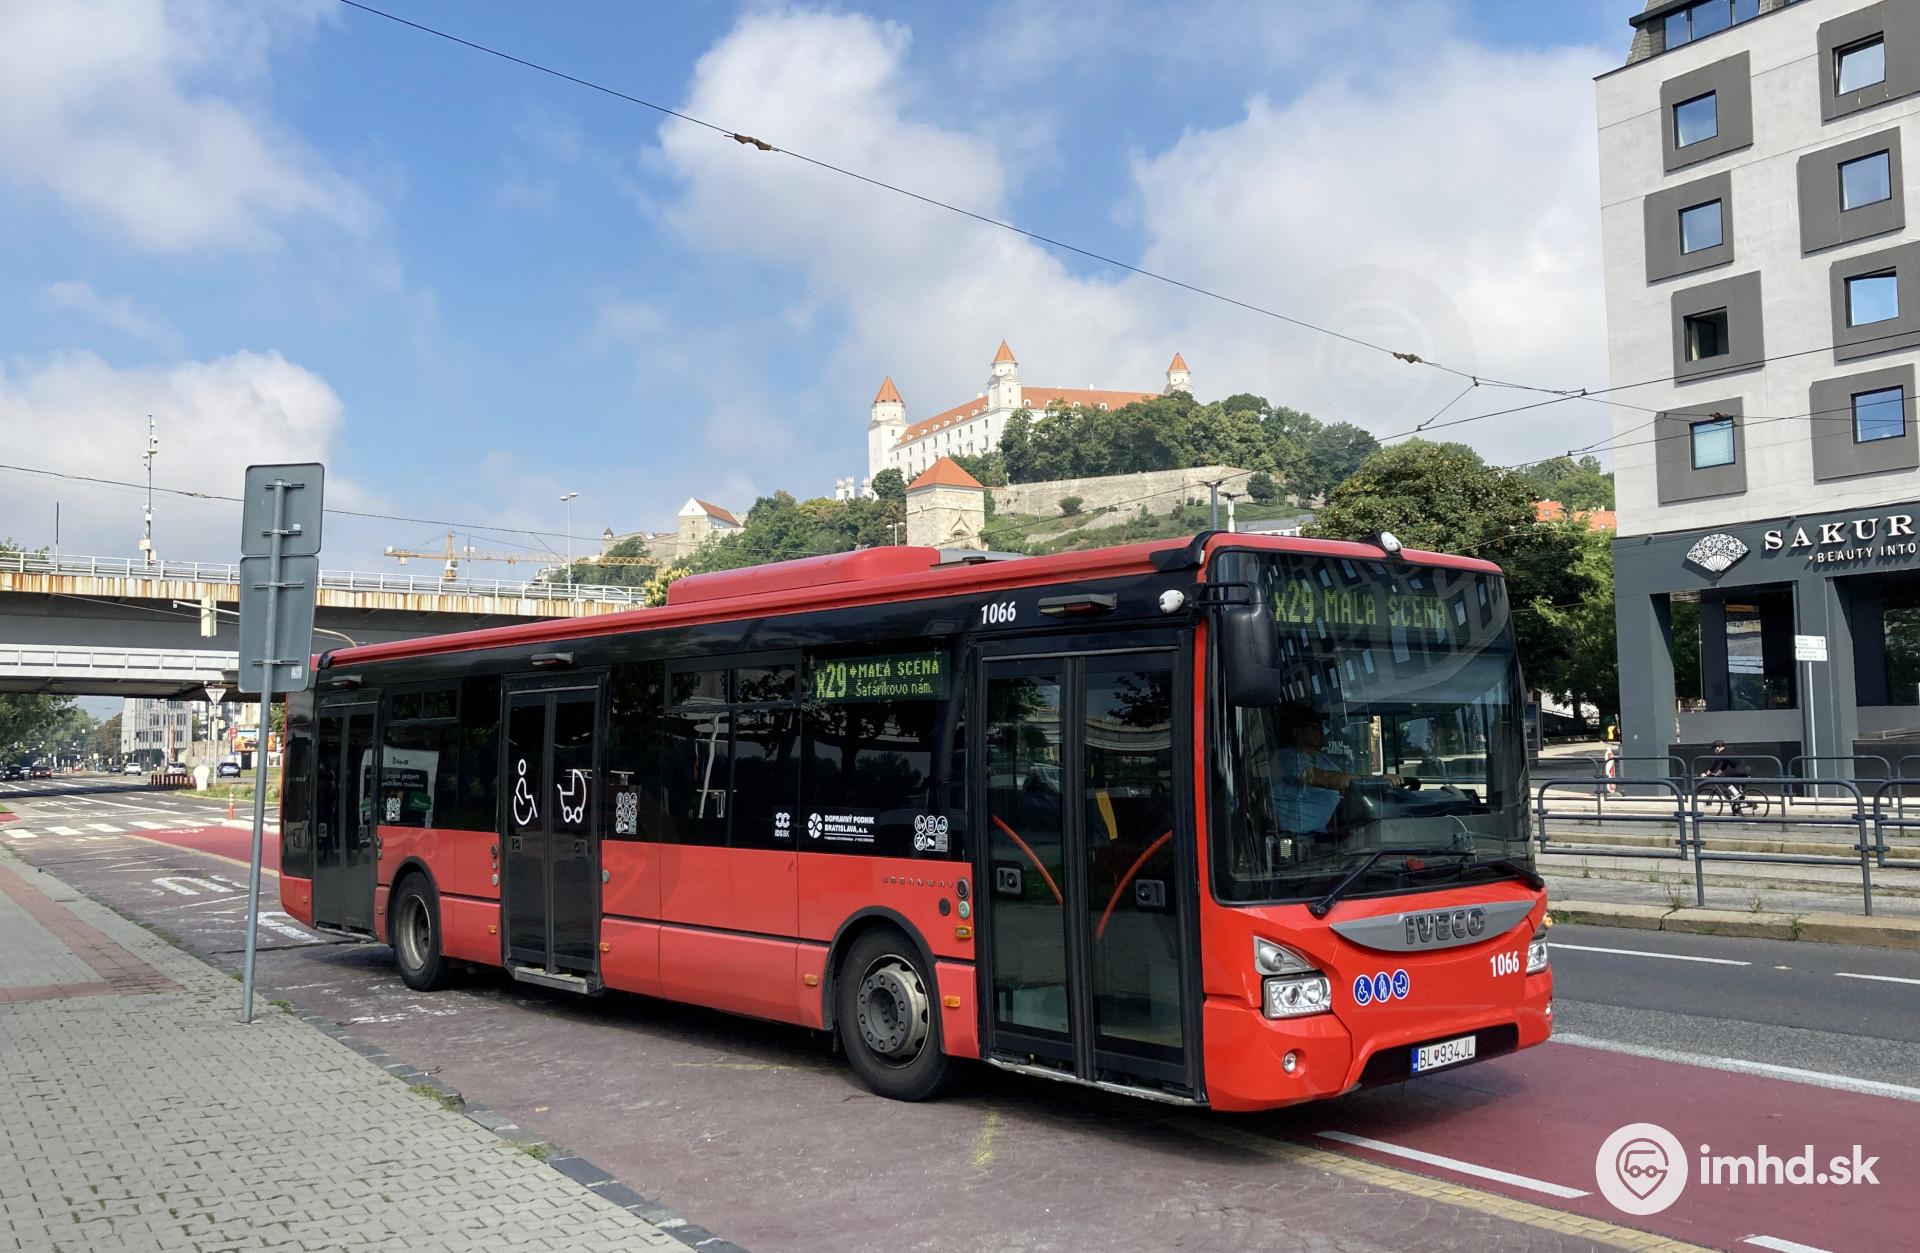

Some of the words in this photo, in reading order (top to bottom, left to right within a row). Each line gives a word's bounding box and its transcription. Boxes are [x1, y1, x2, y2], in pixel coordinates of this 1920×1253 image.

[1764, 515, 1915, 551] SAKUR
[1817, 547, 1873, 563] BEAUTY
[1880, 542, 1916, 557] INTO
[981, 601, 1016, 625] 1066
[1405, 908, 1486, 945] IVECO
[1490, 950, 1520, 978] 1066
